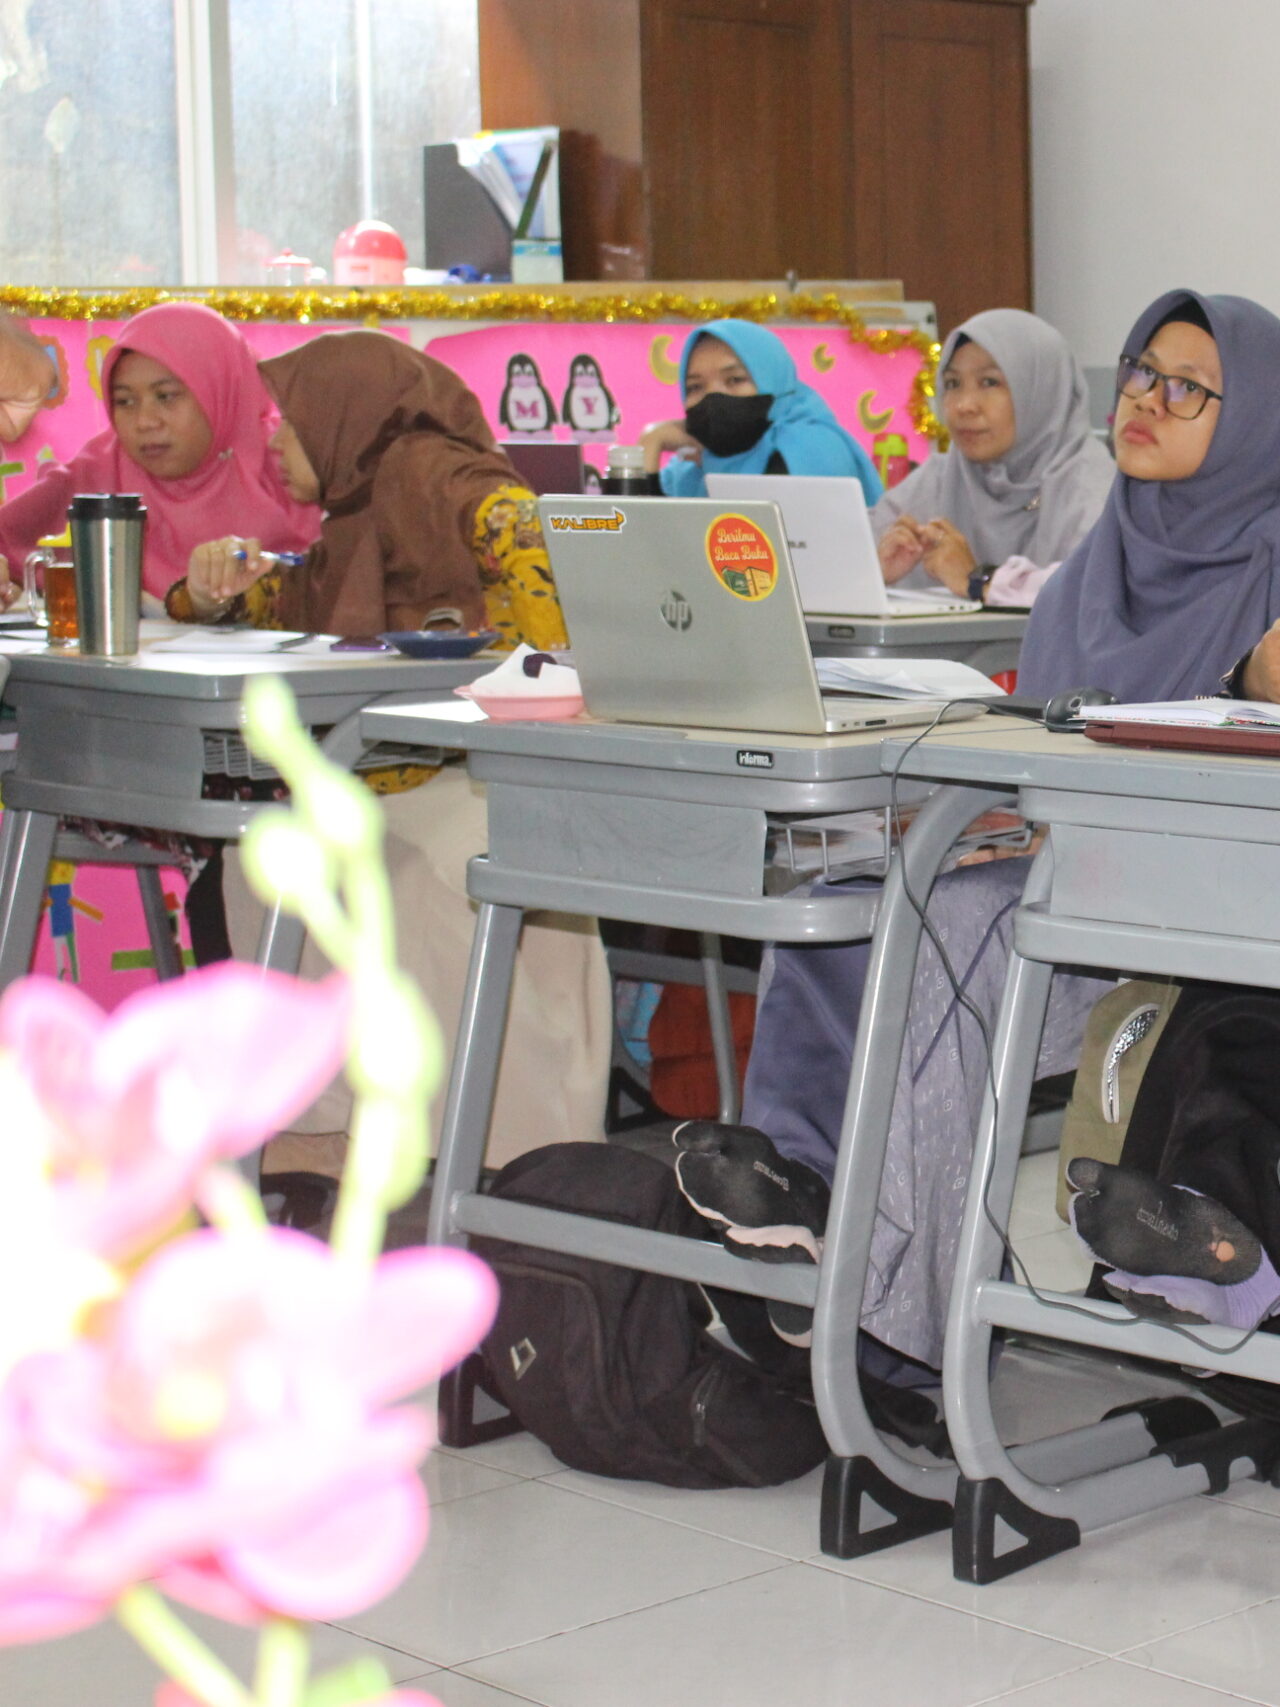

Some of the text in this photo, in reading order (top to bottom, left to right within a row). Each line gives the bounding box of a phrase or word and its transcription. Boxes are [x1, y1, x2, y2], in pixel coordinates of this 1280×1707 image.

[514, 396, 598, 419] M Y
[550, 516, 621, 531] KALIBRE
[715, 545, 769, 561] Baca Buku
[662, 590, 691, 632] hp
